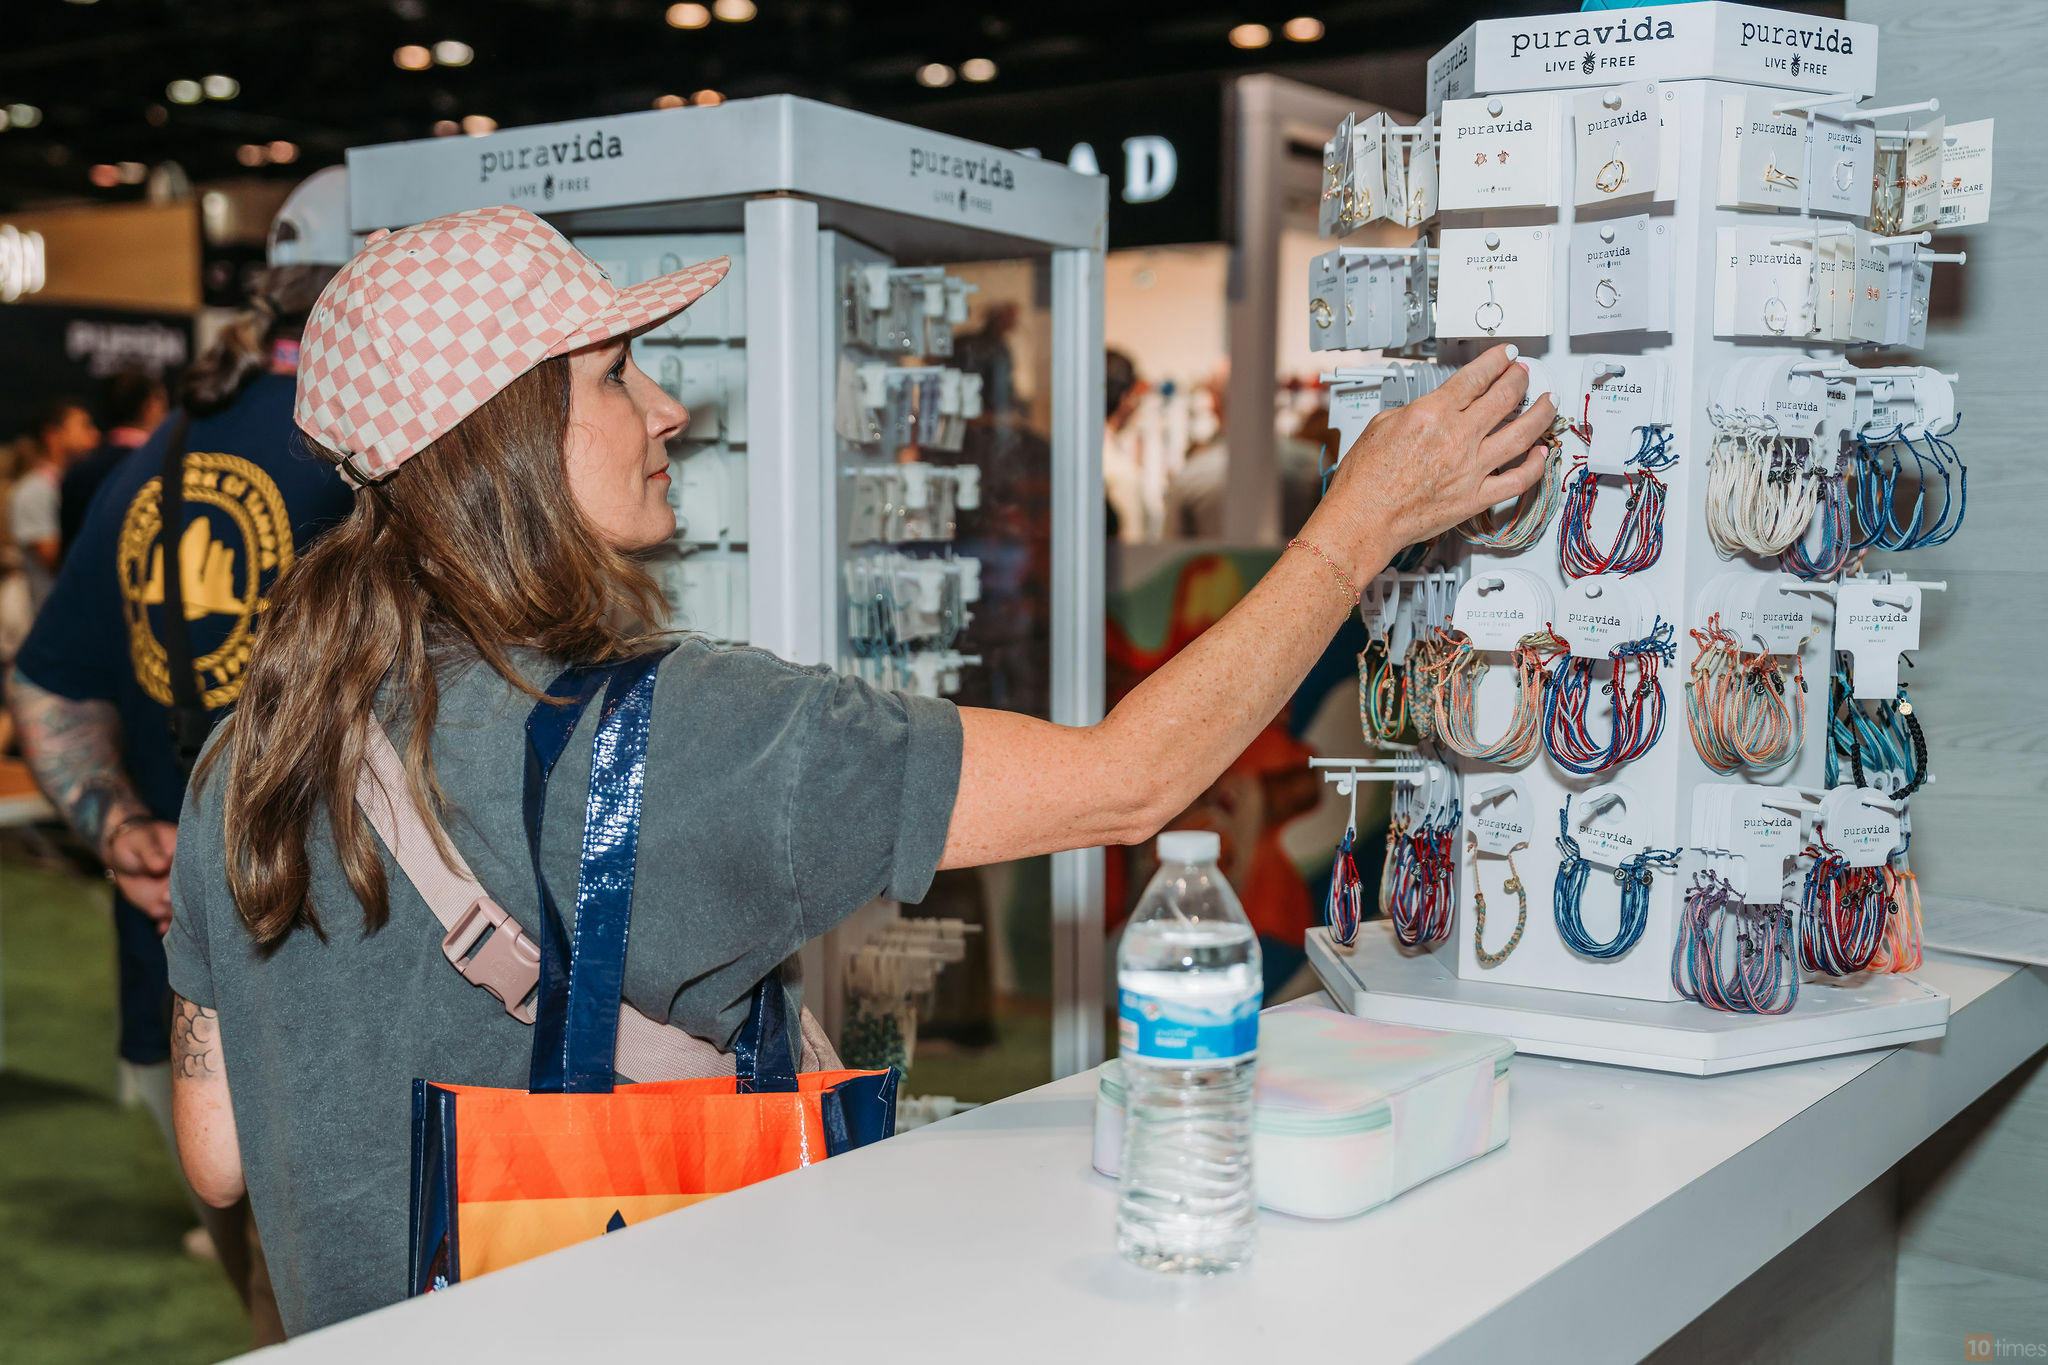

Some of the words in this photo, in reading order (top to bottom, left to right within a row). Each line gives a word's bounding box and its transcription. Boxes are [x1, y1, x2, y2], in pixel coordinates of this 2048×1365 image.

[1511, 15, 1674, 57] puravida
[1741, 22, 1853, 55] puravida
[1545, 60, 1575, 73] LIVE
[1601, 56, 1636, 68] FREE
[1765, 57, 1787, 70] LIVE
[1803, 62, 1827, 75] FREE
[1457, 120, 1533, 139] puravida
[1588, 110, 1647, 135] puravida
[1752, 121, 1797, 137] puravida
[1827, 131, 1862, 145] puravida
[479, 130, 624, 183] puravida
[909, 147, 1016, 191] puravida
[510, 183, 538, 200] LIVE
[558, 177, 590, 193] FREE
[1963, 184, 1984, 193] CARE
[1466, 254, 1518, 265] puravida
[1587, 246, 1631, 263] puravida
[1749, 253, 1802, 265] puravida
[1591, 383, 1642, 394] puravida
[1776, 400, 1818, 412] puravida
[1466, 610, 1524, 620] puravida
[1568, 613, 1621, 627] puravida
[1763, 612, 1803, 623] puravida
[1849, 613, 1908, 624] puravida
[1477, 818, 1523, 833] puravida
[1843, 825, 1890, 837] puravida
[1579, 826, 1633, 845] puravida
